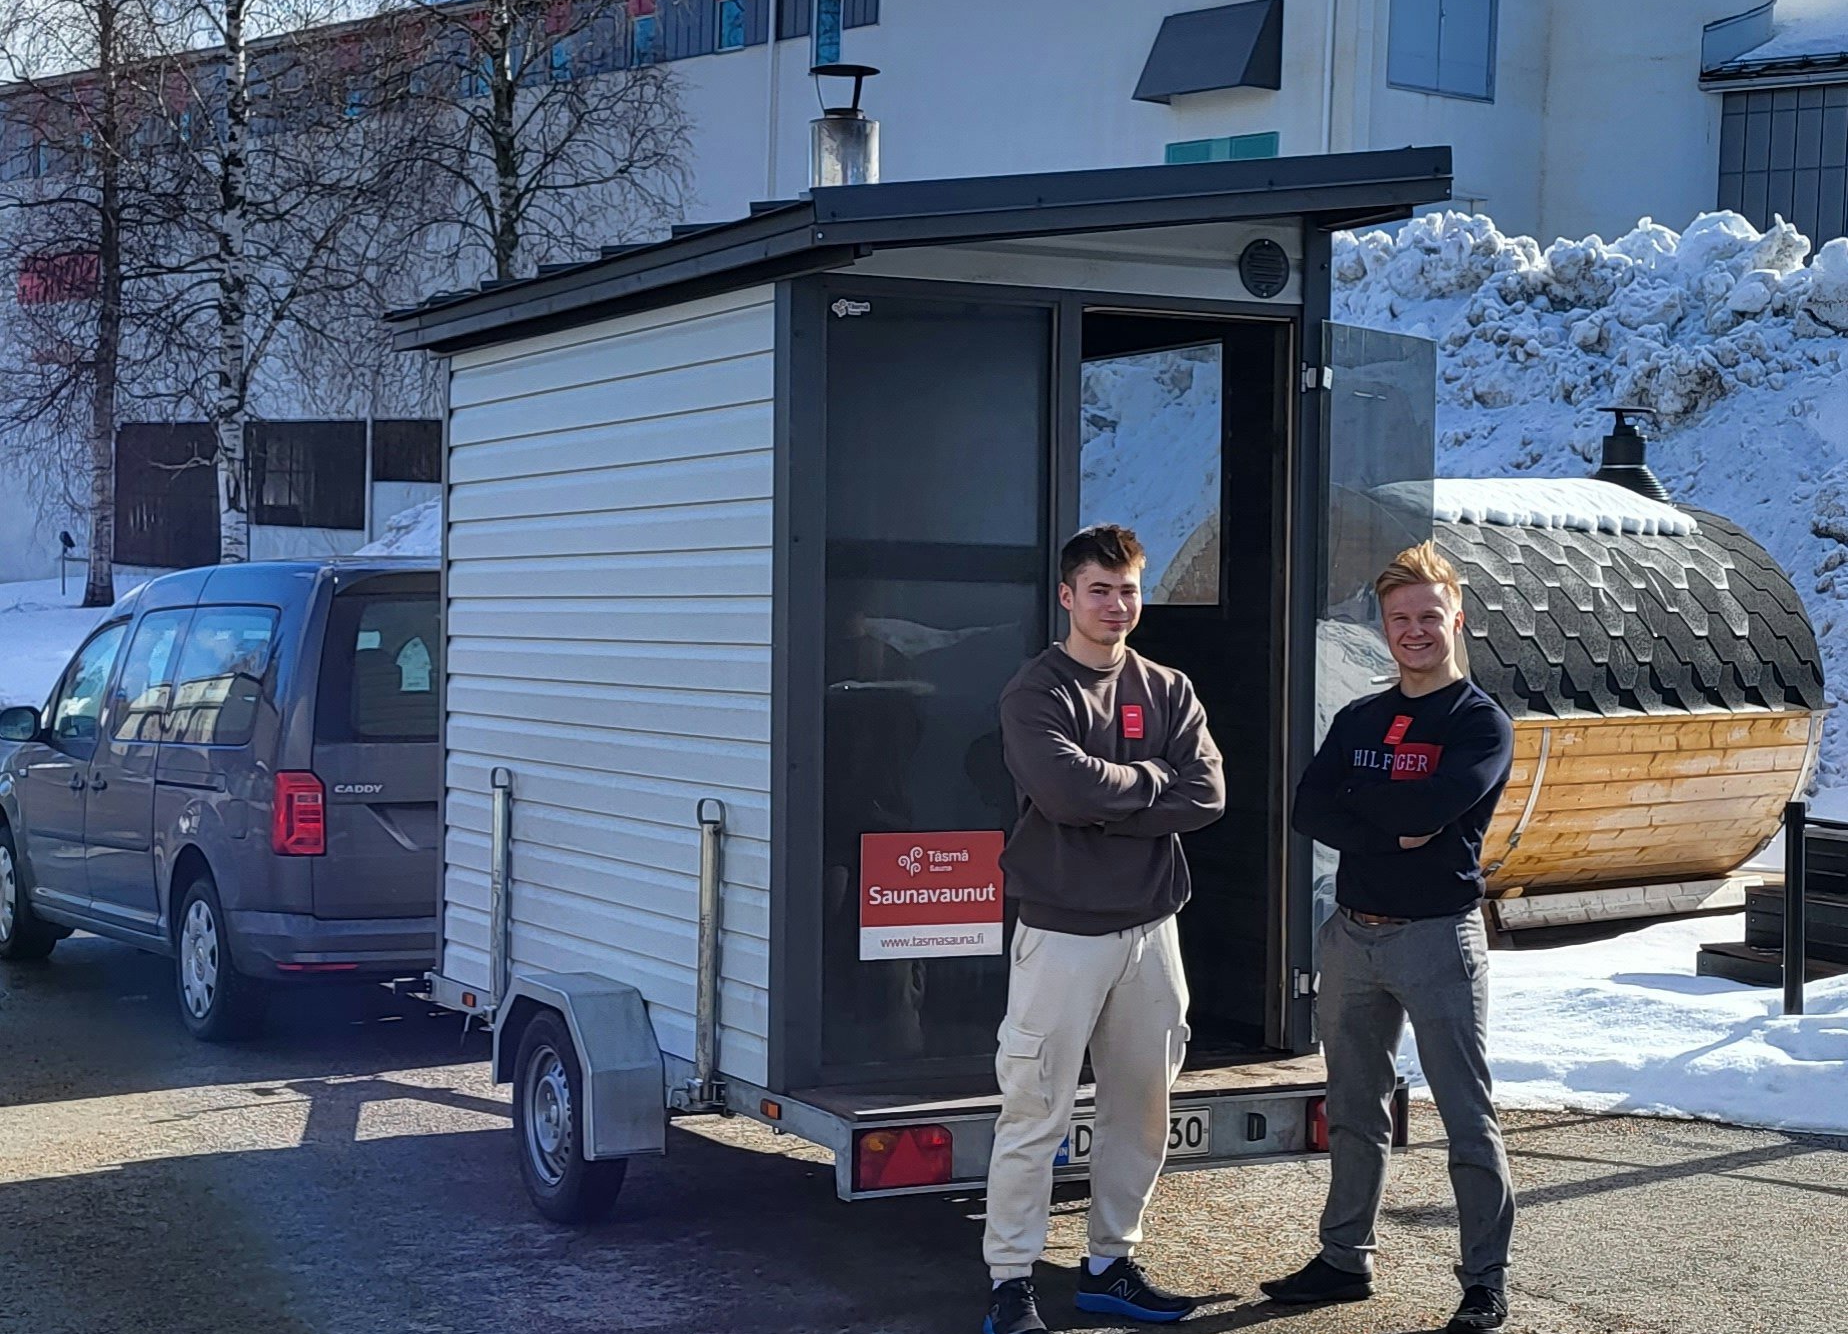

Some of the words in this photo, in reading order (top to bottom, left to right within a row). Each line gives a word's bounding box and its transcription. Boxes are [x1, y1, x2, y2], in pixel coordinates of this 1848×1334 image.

[1353, 749, 1428, 772] HILFIGER
[334, 784, 384, 794] CADDY
[927, 849, 969, 863] Täsmä
[869, 883, 996, 905] Saunavaunut
[880, 933, 984, 948] www.tasmasauna.fi
